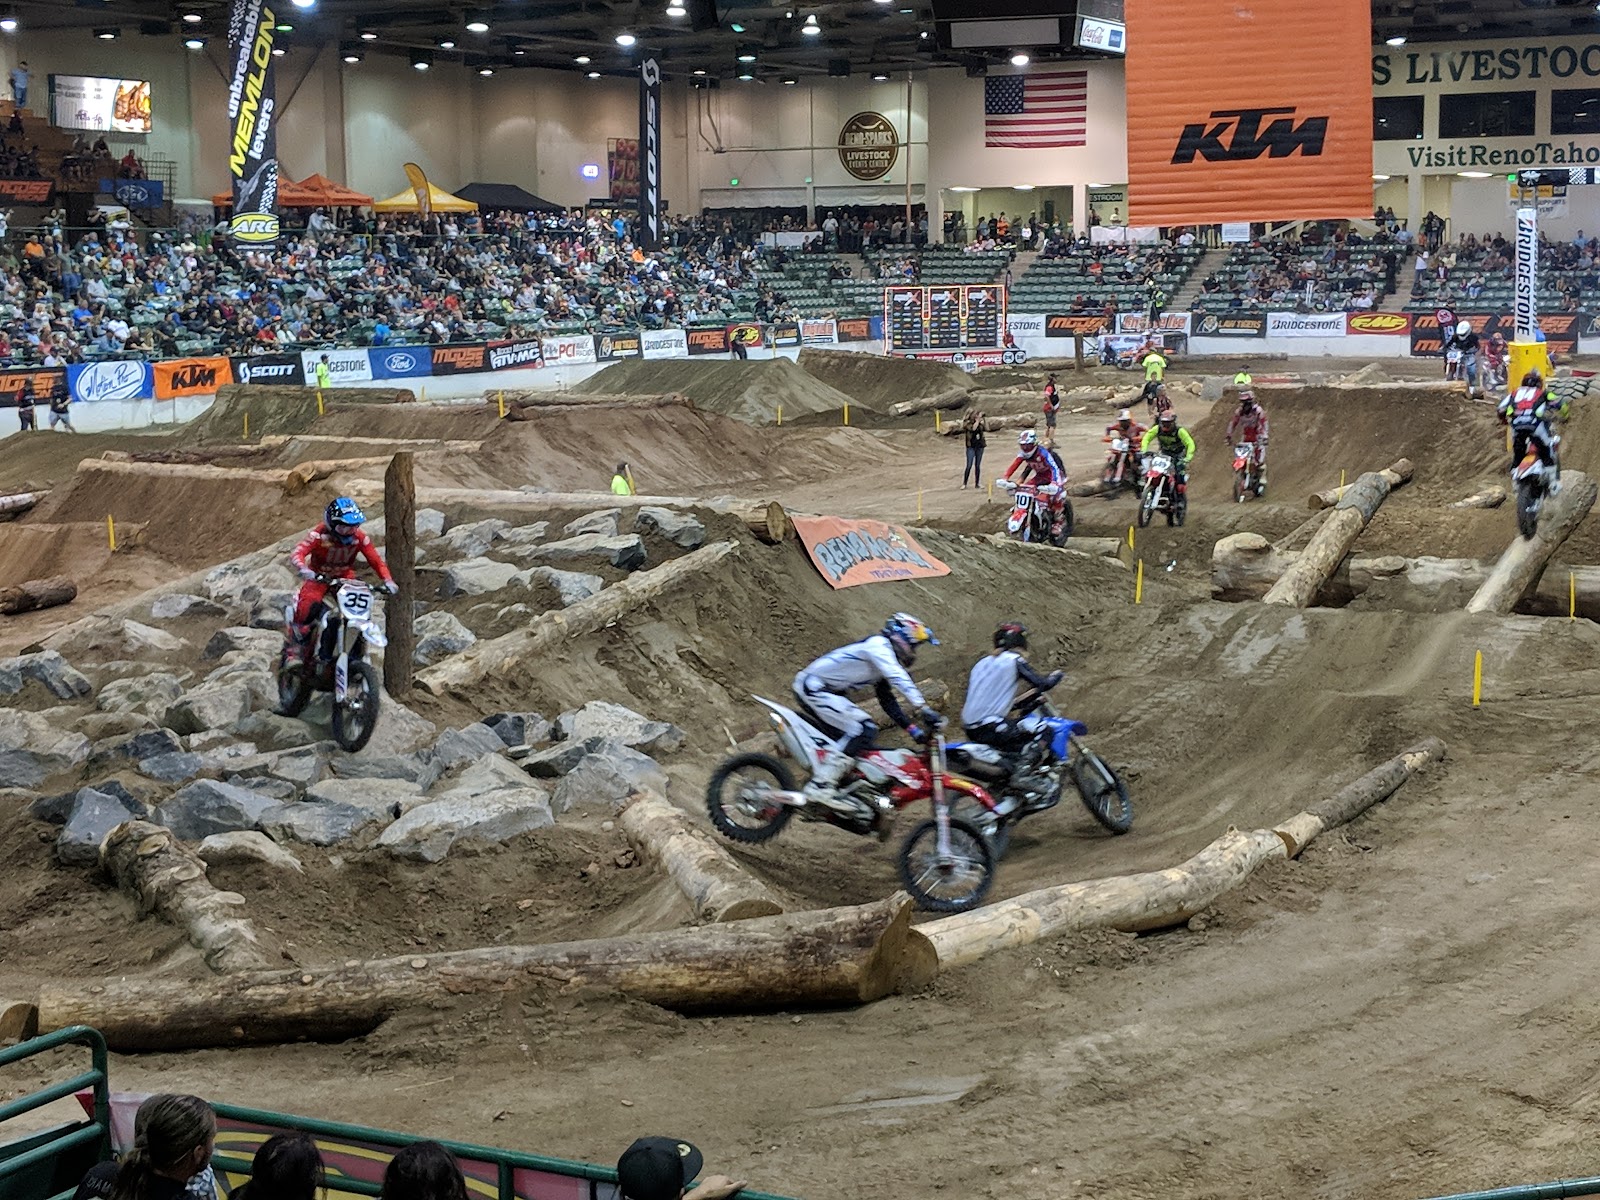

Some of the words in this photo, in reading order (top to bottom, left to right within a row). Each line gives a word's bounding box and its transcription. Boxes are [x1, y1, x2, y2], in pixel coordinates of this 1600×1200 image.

[230, 7, 275, 178] MEMLON
[248, 98, 274, 160] levers
[1170, 106, 1330, 165] KTM
[846, 150, 891, 160] LIVESTOCK
[646, 89, 657, 242] SCOTT
[230, 219, 280, 233] ARC
[1516, 218, 1533, 337] BRIDGESTONE
[1271, 320, 1343, 330] BRIDGESTONE
[1350, 316, 1408, 328] FMF
[559, 343, 576, 358] PCI
[390, 355, 411, 369] Ford
[171, 364, 216, 390] KTM
[250, 364, 296, 377] SCOTT
[343, 592, 370, 609] 35
